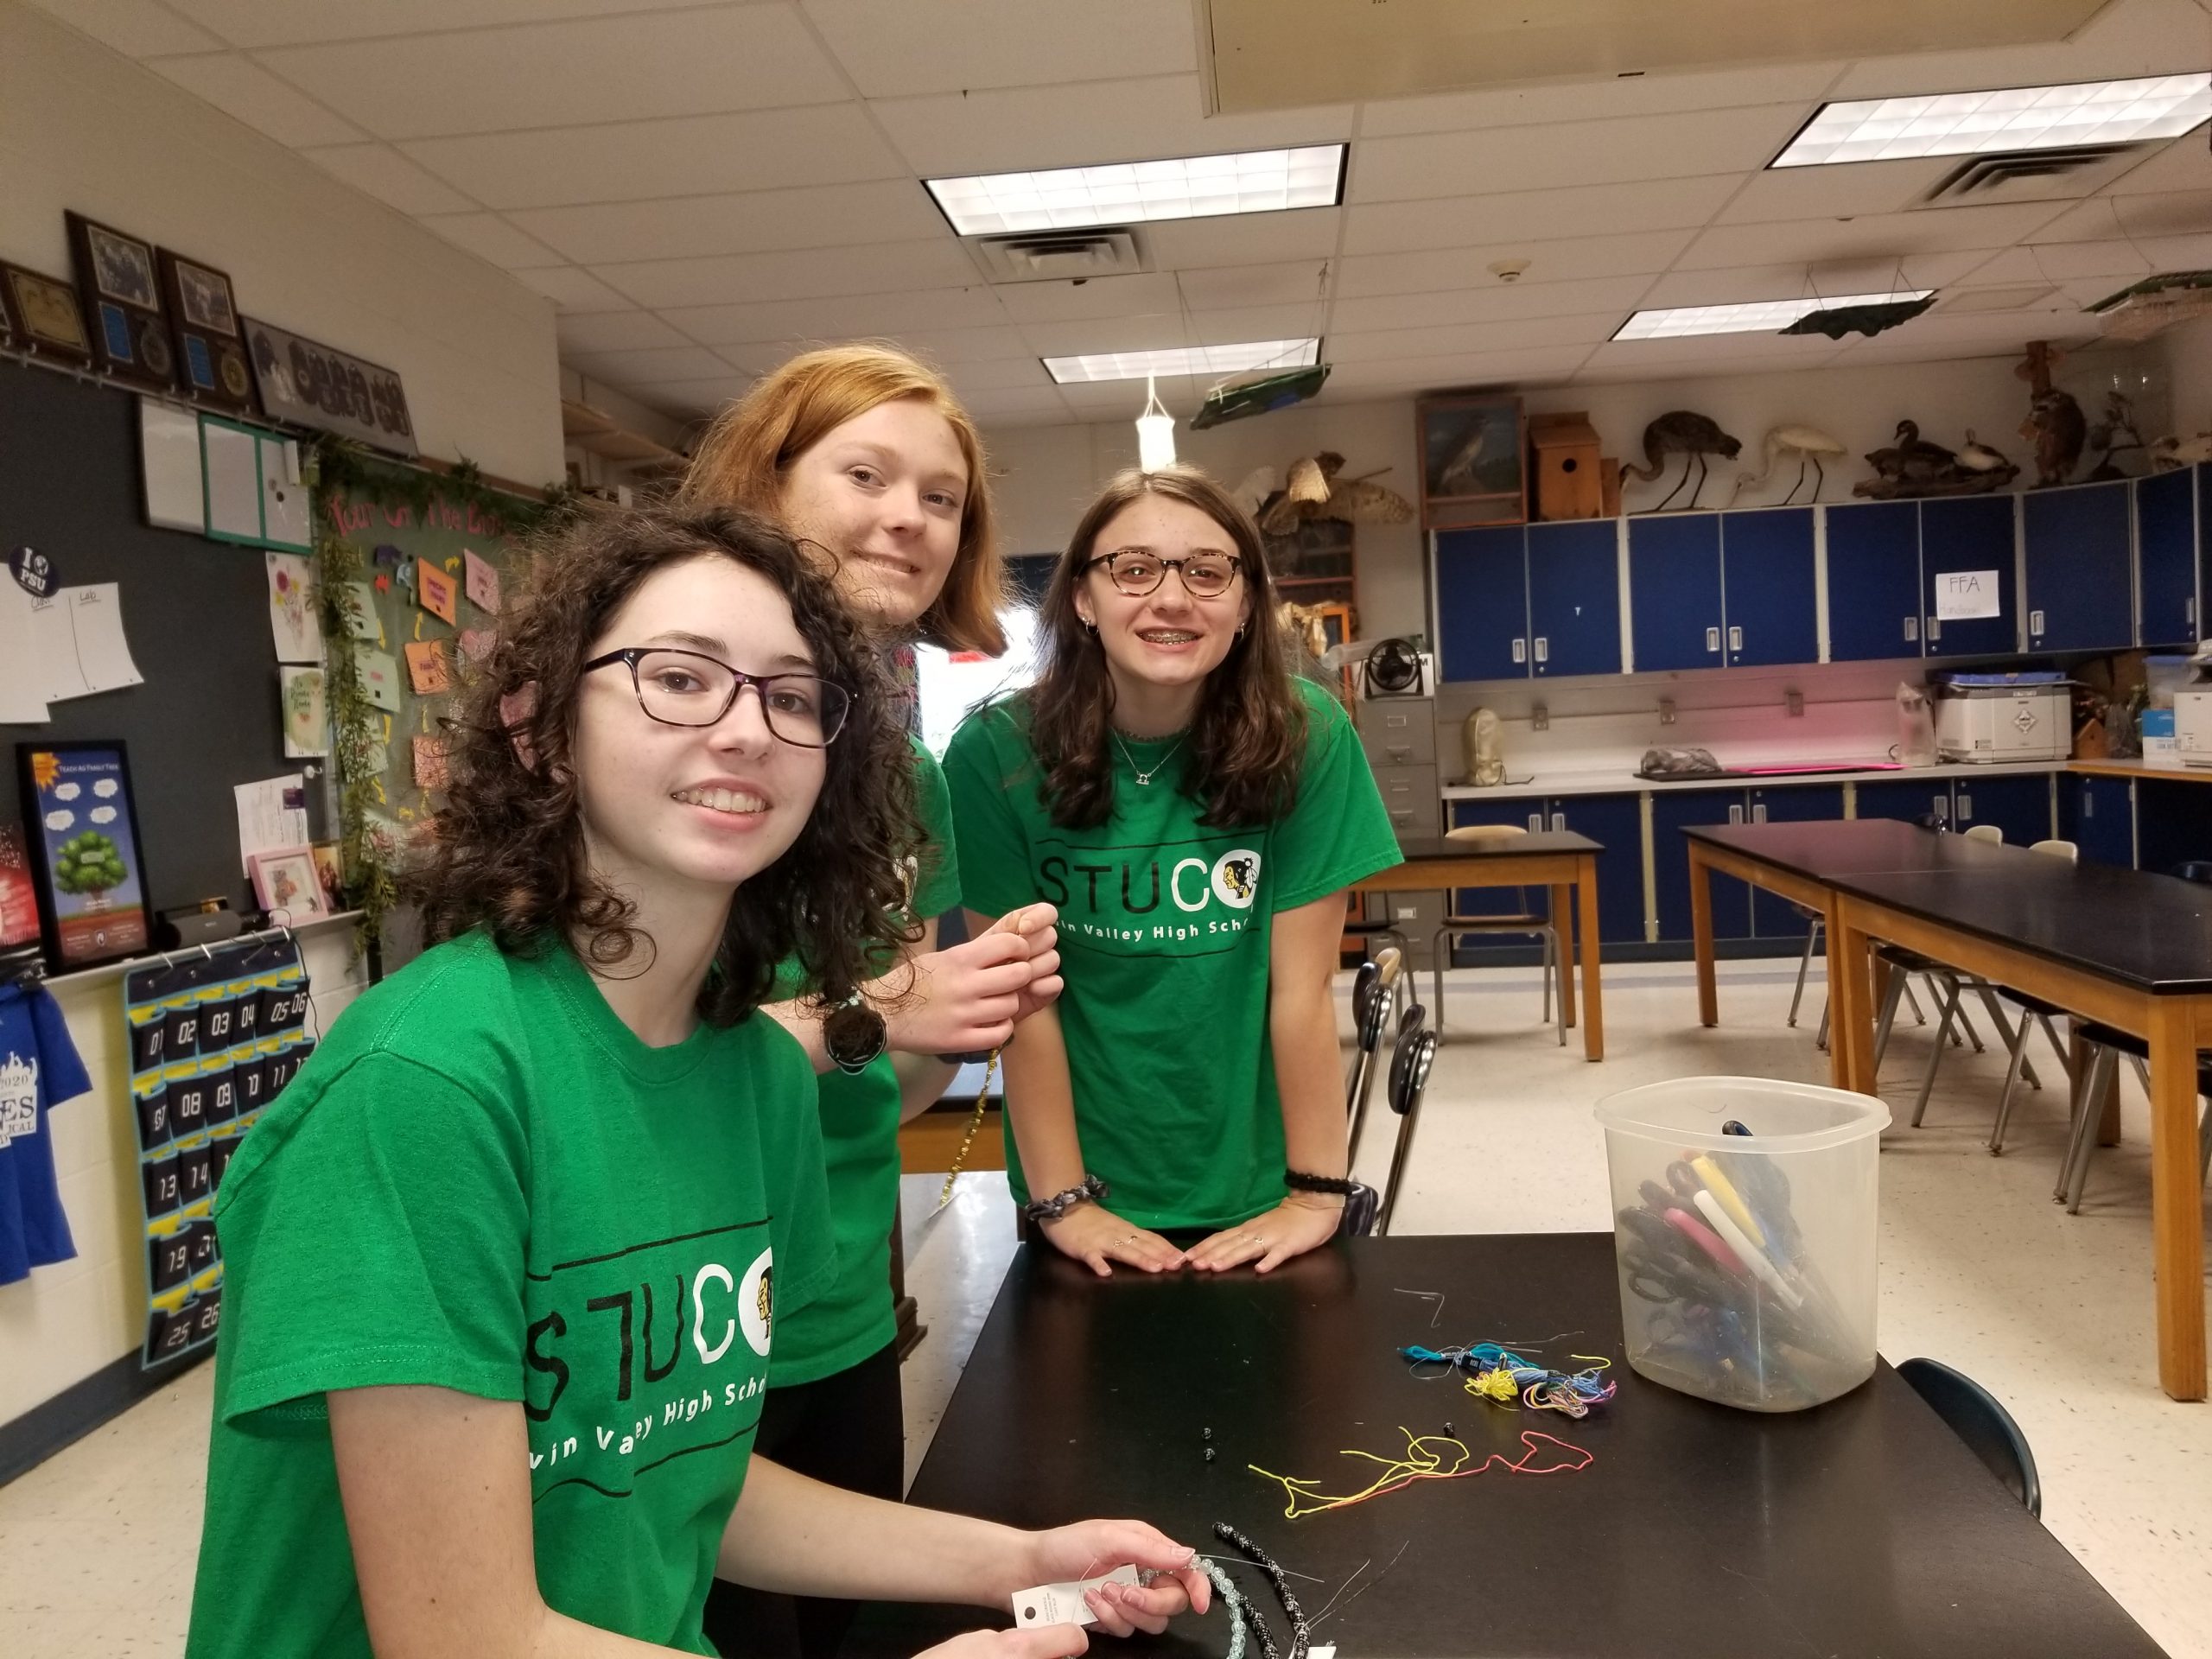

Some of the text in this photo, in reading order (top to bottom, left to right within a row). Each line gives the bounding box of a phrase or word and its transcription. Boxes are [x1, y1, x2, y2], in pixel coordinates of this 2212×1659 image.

[22, 547, 33, 569] I
[20, 569, 46, 592] PSU
[1949, 576, 1980, 594] FFA
[79, 589, 97, 601] Lab
[1084, 924, 1143, 942] Valley
[1154, 924, 1198, 941] High
[149, 992, 307, 1055] 01 02 03 04 05 06
[0, 1075, 29, 1087] 020
[181, 1092, 201, 1117] 08
[216, 1083, 231, 1108] 09
[248, 1074, 259, 1097] 10
[273, 1065, 285, 1087] 11
[161, 1174, 176, 1200] 13
[192, 1162, 208, 1188] 14
[169, 1245, 187, 1272] 19
[168, 1303, 220, 1346] 25 26
[596, 1415, 652, 1454] Vaey
[663, 1390, 712, 1426] High
